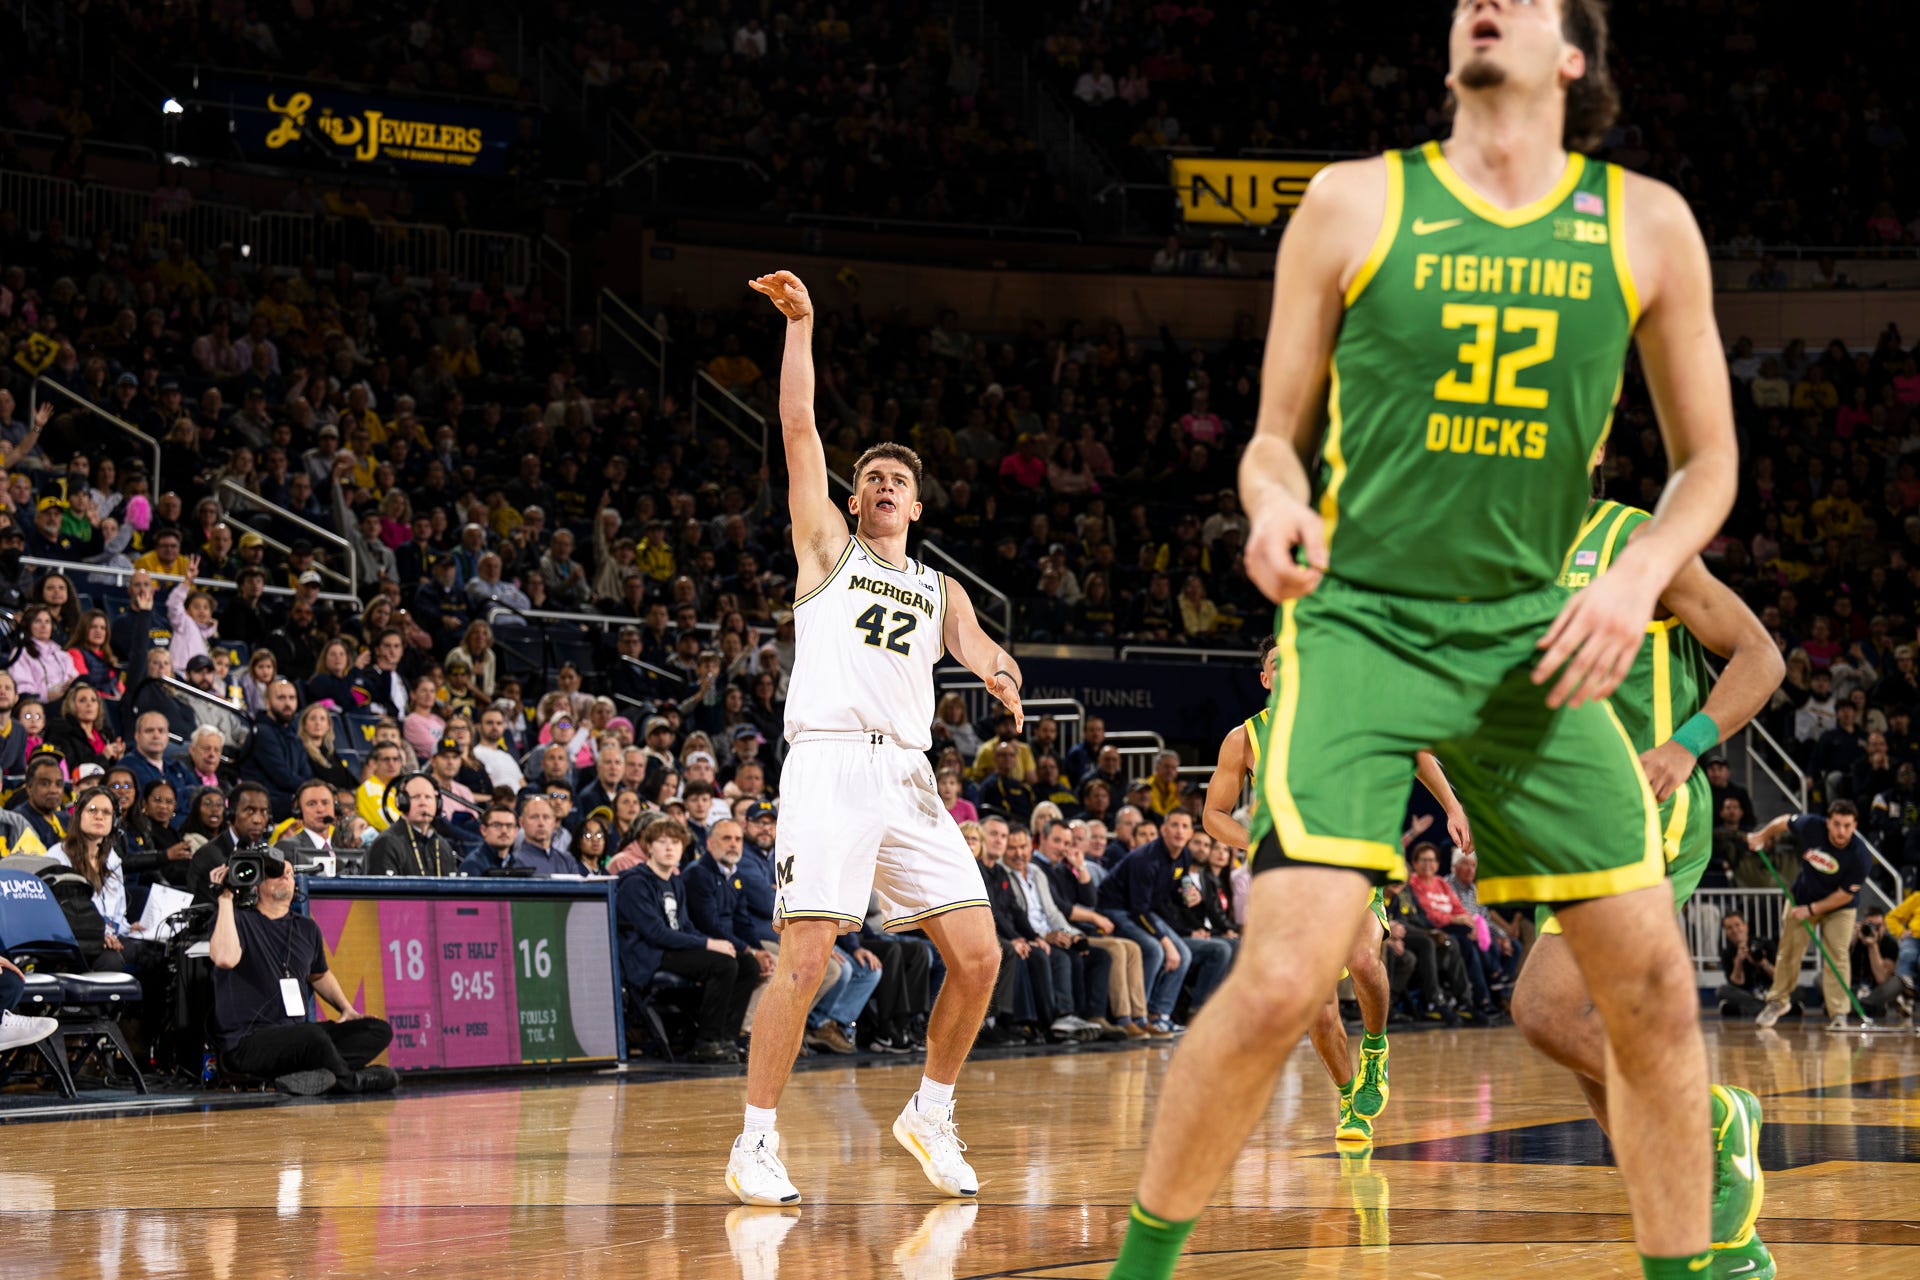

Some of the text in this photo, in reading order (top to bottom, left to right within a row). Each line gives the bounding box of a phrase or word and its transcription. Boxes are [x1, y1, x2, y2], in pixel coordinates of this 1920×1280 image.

[354, 109, 483, 162] JEWELERS
[1414, 253, 1593, 300] FIGHTING
[1434, 303, 1559, 409] 32
[1425, 413, 1548, 460] DUCKS
[848, 575, 935, 619] MICHIGAN
[855, 603, 918, 656] 42
[1081, 687, 1154, 709] TUNNEL
[776, 855, 795, 889] M
[389, 939, 425, 981] 18
[443, 942, 499, 959] 1ST HALF
[518, 938, 551, 978] 16
[451, 970, 495, 1001] 9:45
[389, 1013, 432, 1029] FOULS 3
[465, 1022, 489, 1037] POSS
[519, 1009, 558, 1025] FOULS 3
[396, 1032, 427, 1049] TOL 4
[526, 1027, 555, 1043] TOL 4
